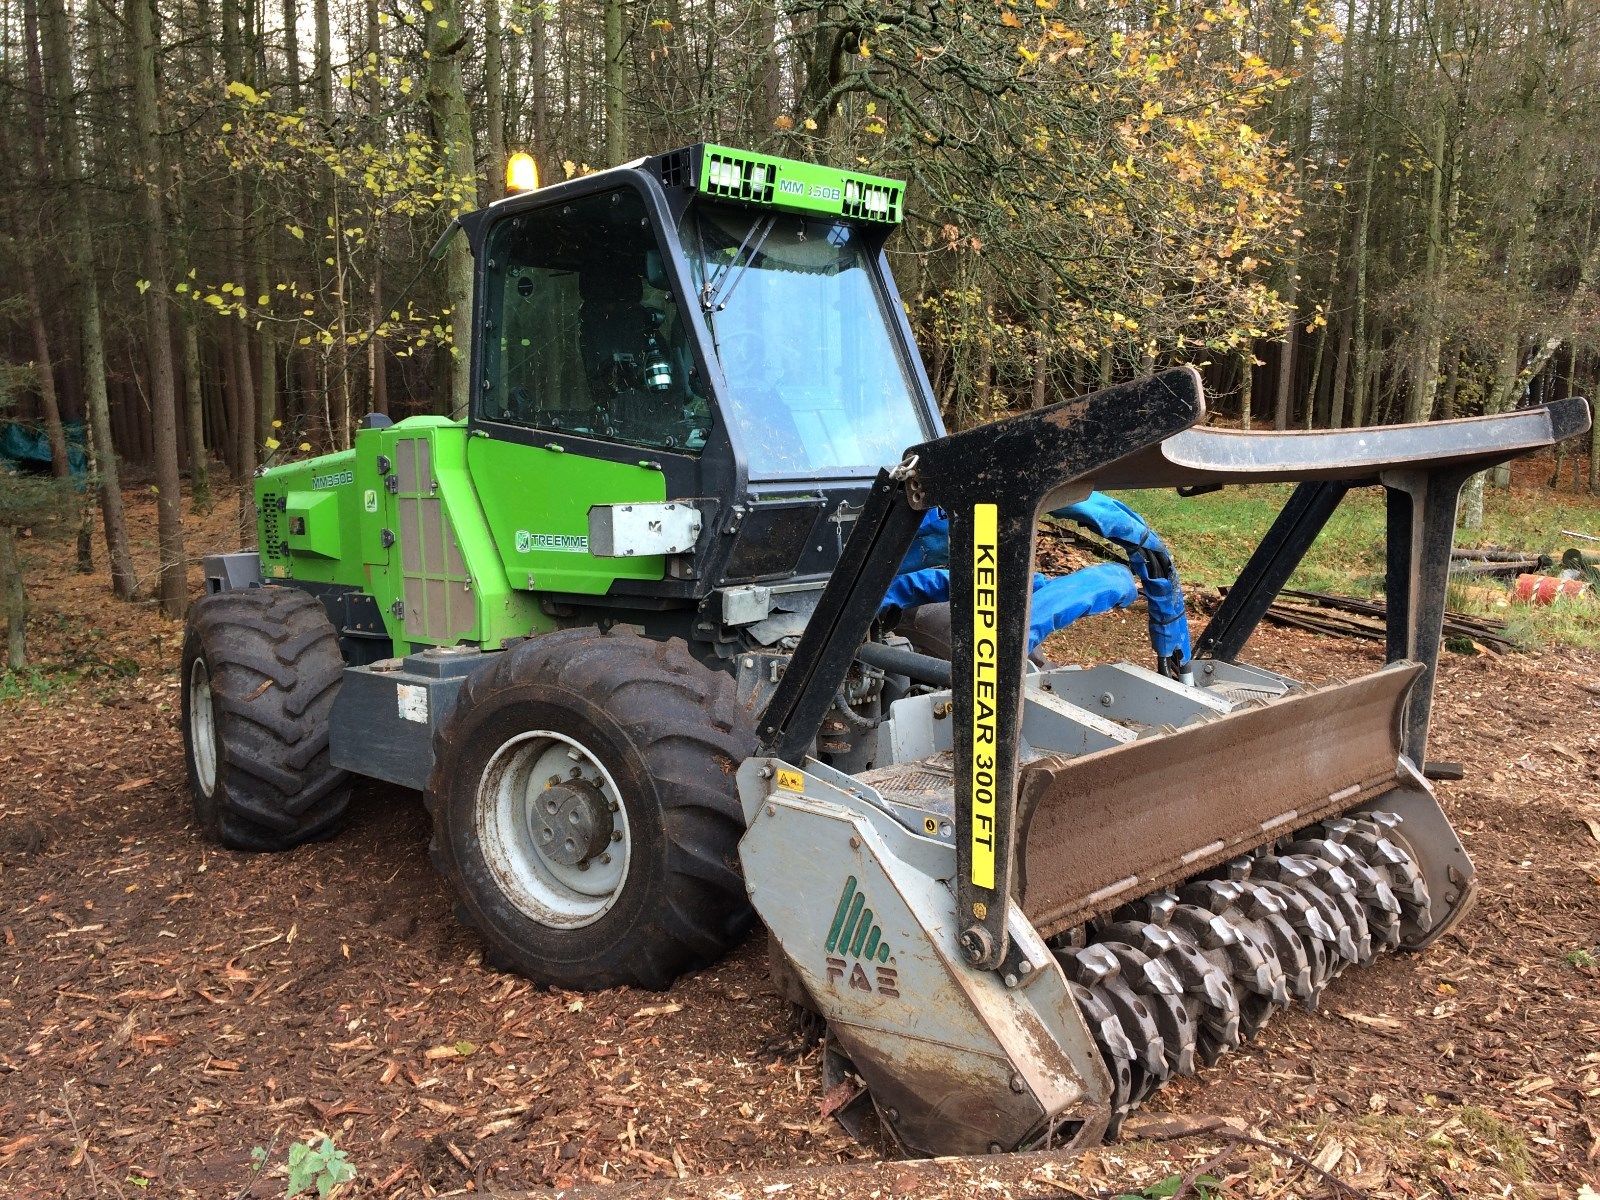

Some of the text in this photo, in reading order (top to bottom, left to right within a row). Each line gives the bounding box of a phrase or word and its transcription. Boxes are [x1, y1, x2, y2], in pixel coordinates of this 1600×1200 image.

[780, 179, 804, 194] MM
[312, 470, 354, 491] MM350B
[531, 534, 588, 548] TREEMME
[975, 544, 995, 852] KEEP CLEAR 300 FT
[826, 957, 900, 999] FAE
